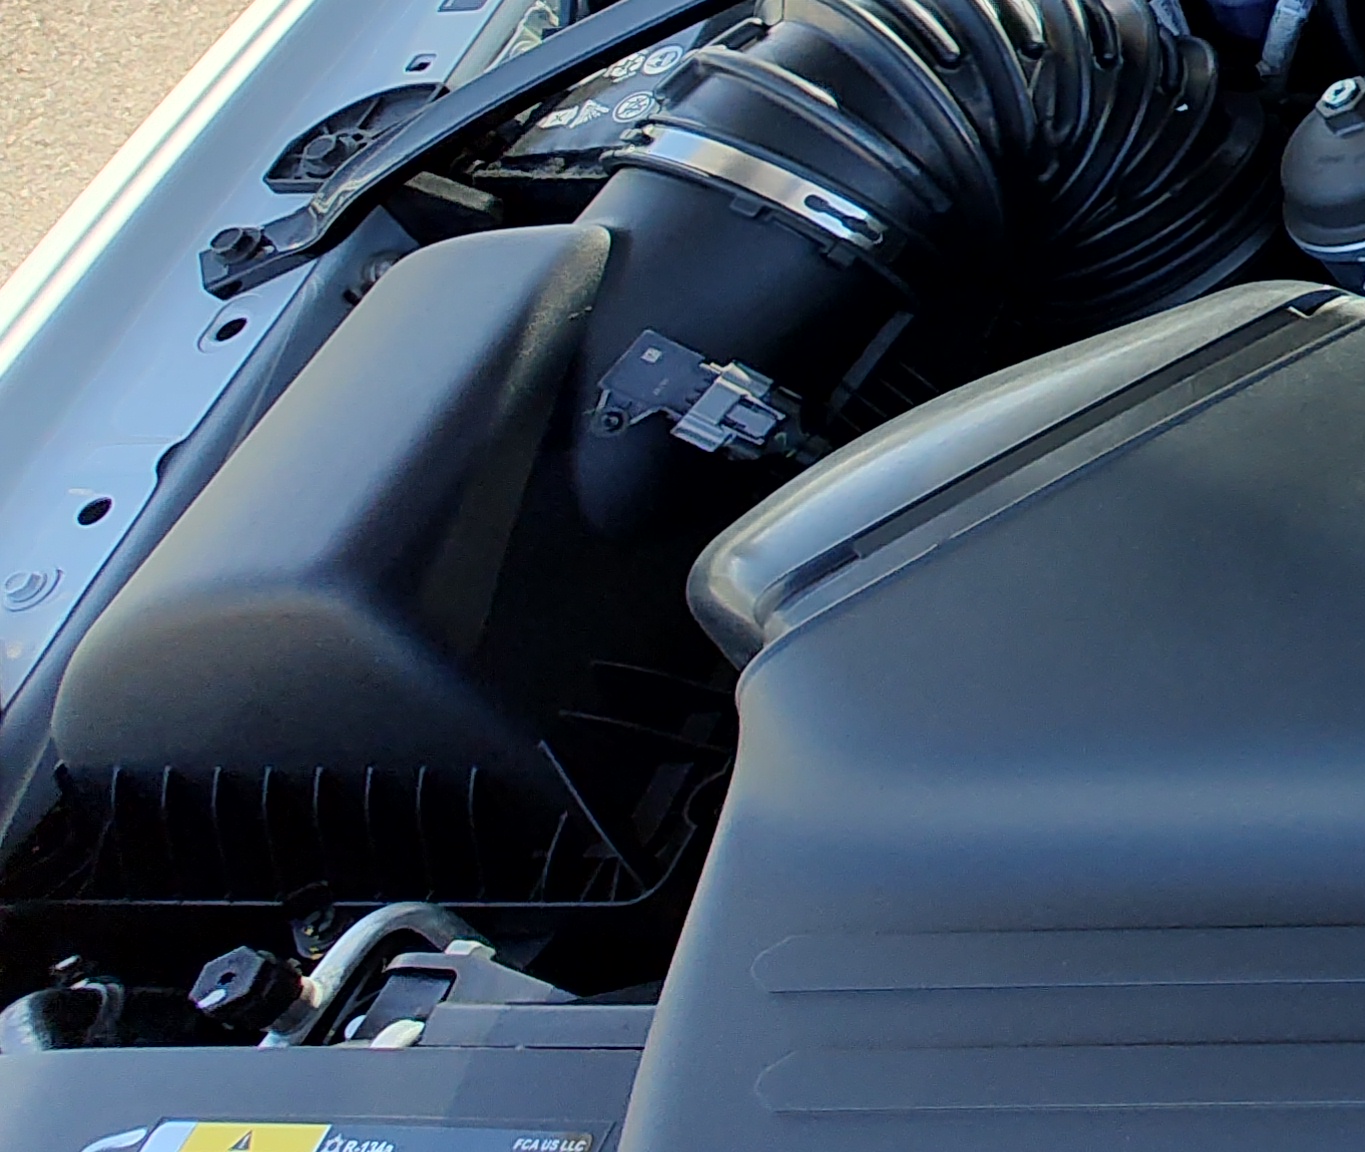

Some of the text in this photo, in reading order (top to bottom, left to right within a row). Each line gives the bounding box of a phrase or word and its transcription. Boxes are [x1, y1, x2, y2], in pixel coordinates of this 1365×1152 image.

[512, 1137, 587, 1152] FCA US LLC
